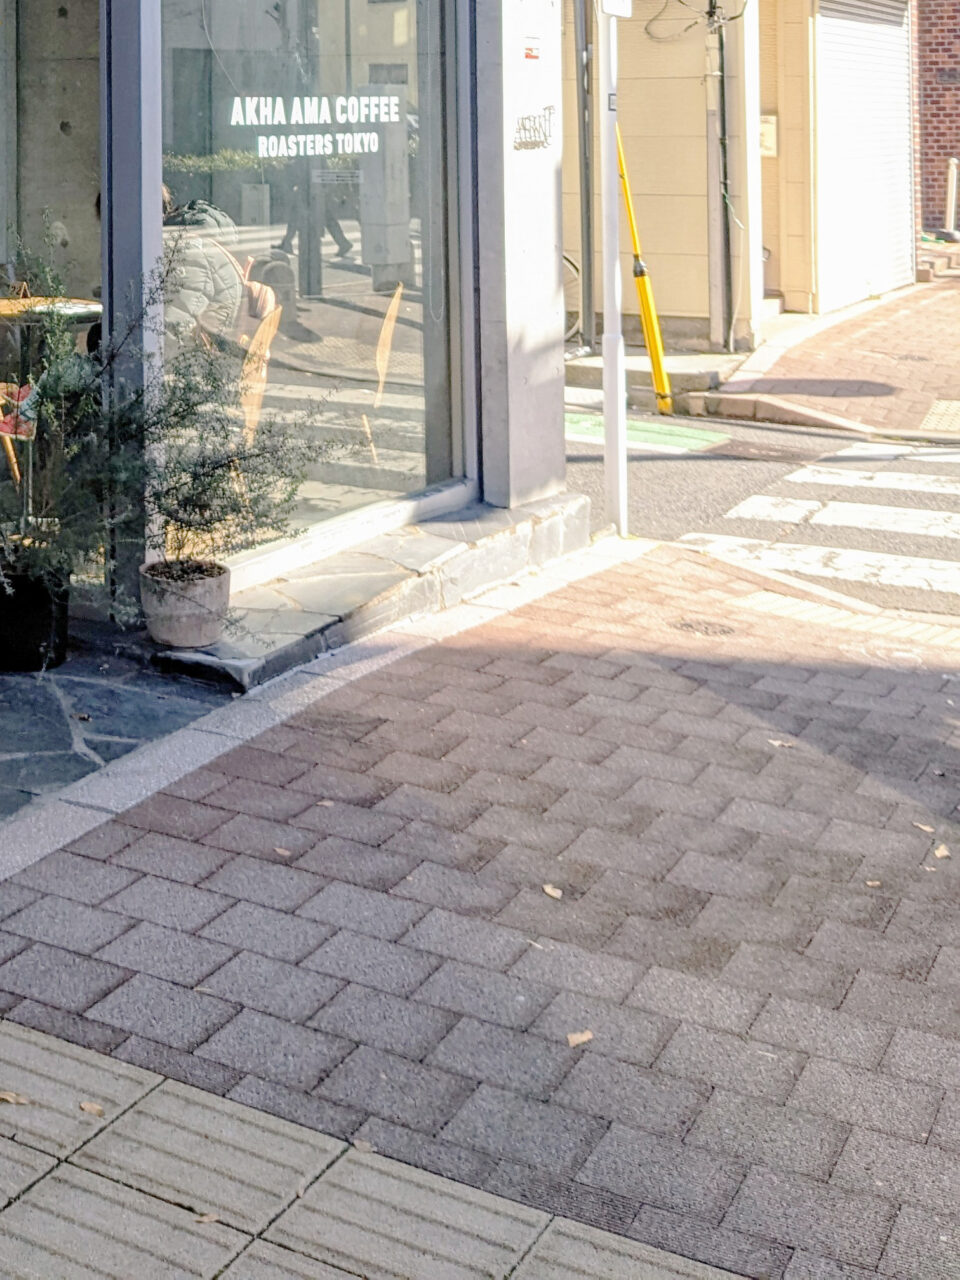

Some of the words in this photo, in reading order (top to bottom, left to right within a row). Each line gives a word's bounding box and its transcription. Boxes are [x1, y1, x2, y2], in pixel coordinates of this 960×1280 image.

[230, 96, 287, 126] AKHA
[290, 96, 332, 125] AMA
[335, 95, 400, 124] COFFEE
[258, 134, 333, 158] ROASTERS
[336, 132, 379, 154] TOKYO
